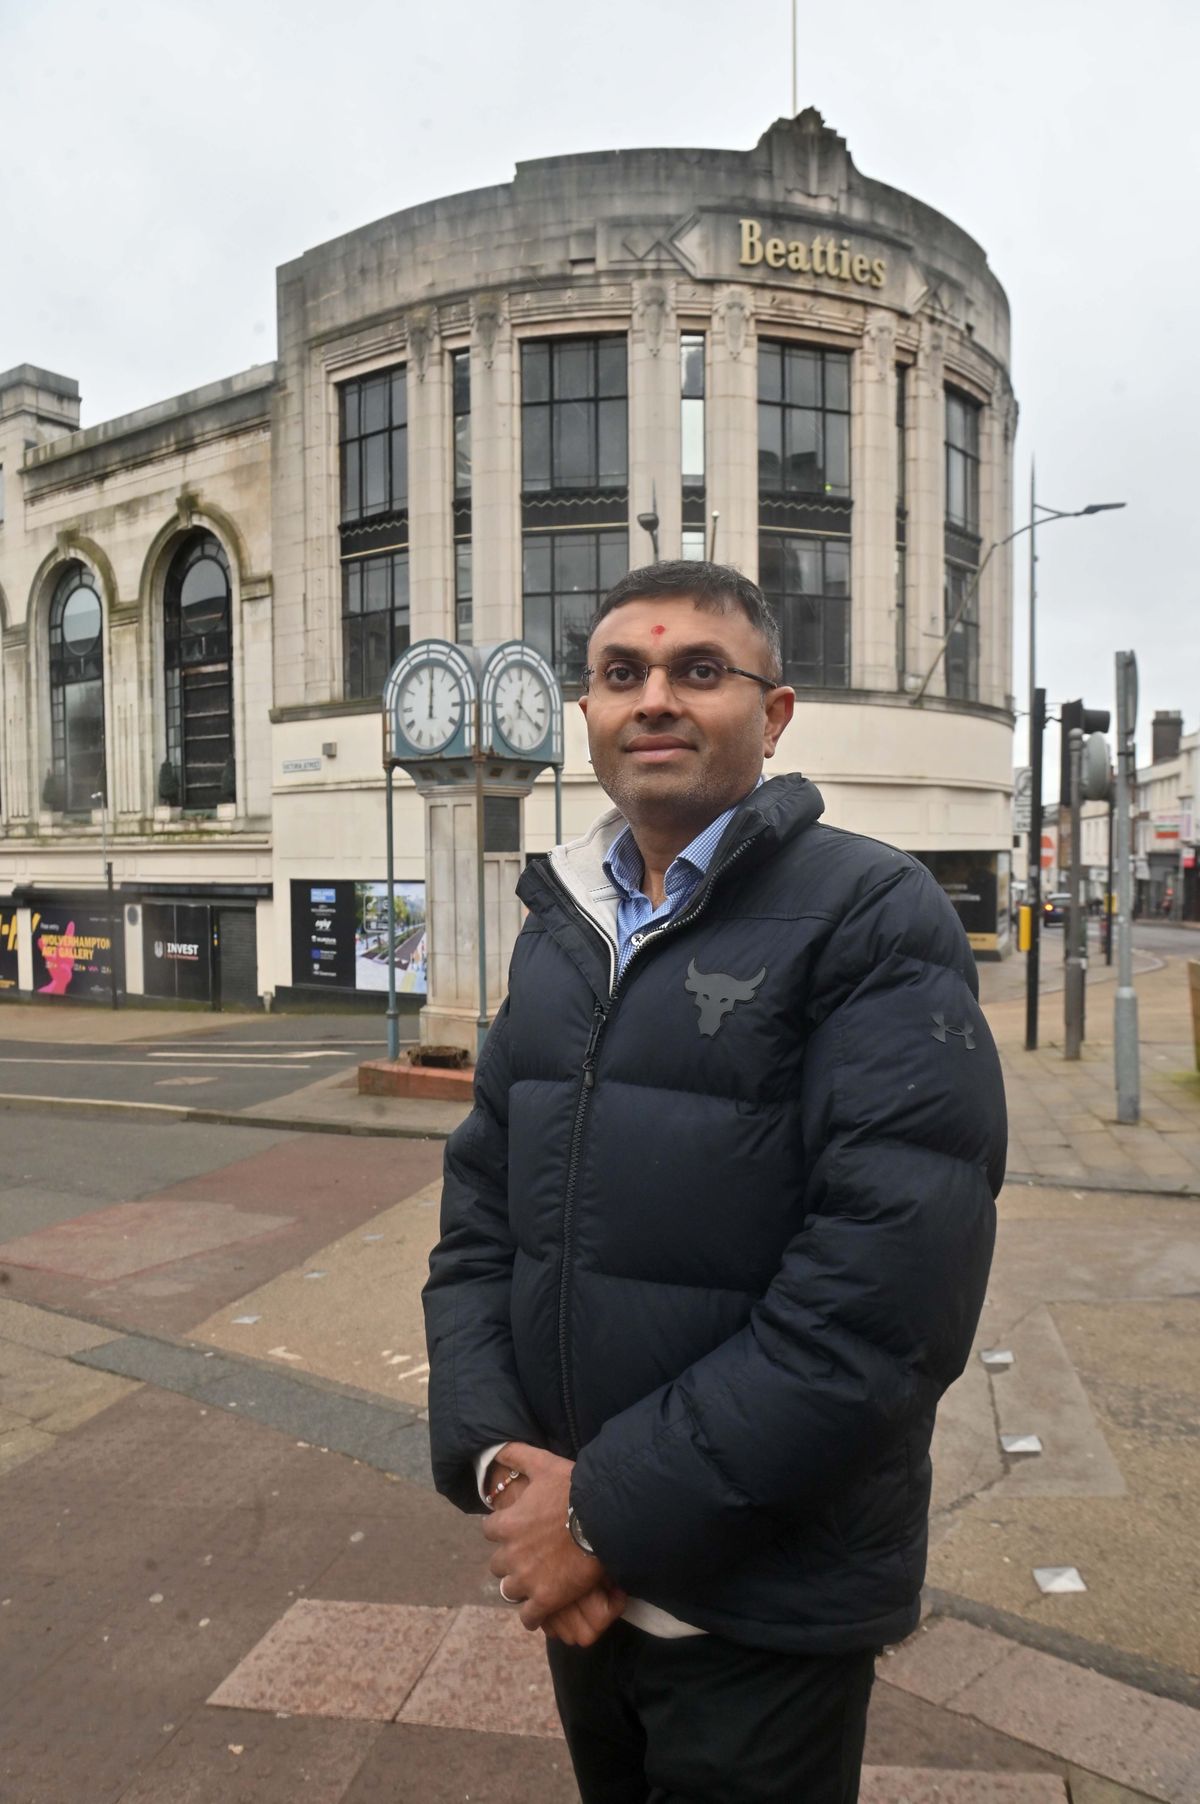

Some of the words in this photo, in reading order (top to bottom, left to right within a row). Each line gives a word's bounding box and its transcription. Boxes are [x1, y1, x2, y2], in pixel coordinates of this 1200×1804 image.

[739, 218, 888, 287] Beatties
[41, 934, 111, 950] WOLVERHAMPTON
[167, 942, 199, 955] INVEST
[42, 947, 57, 957] ART
[58, 947, 94, 961] GALLERY
